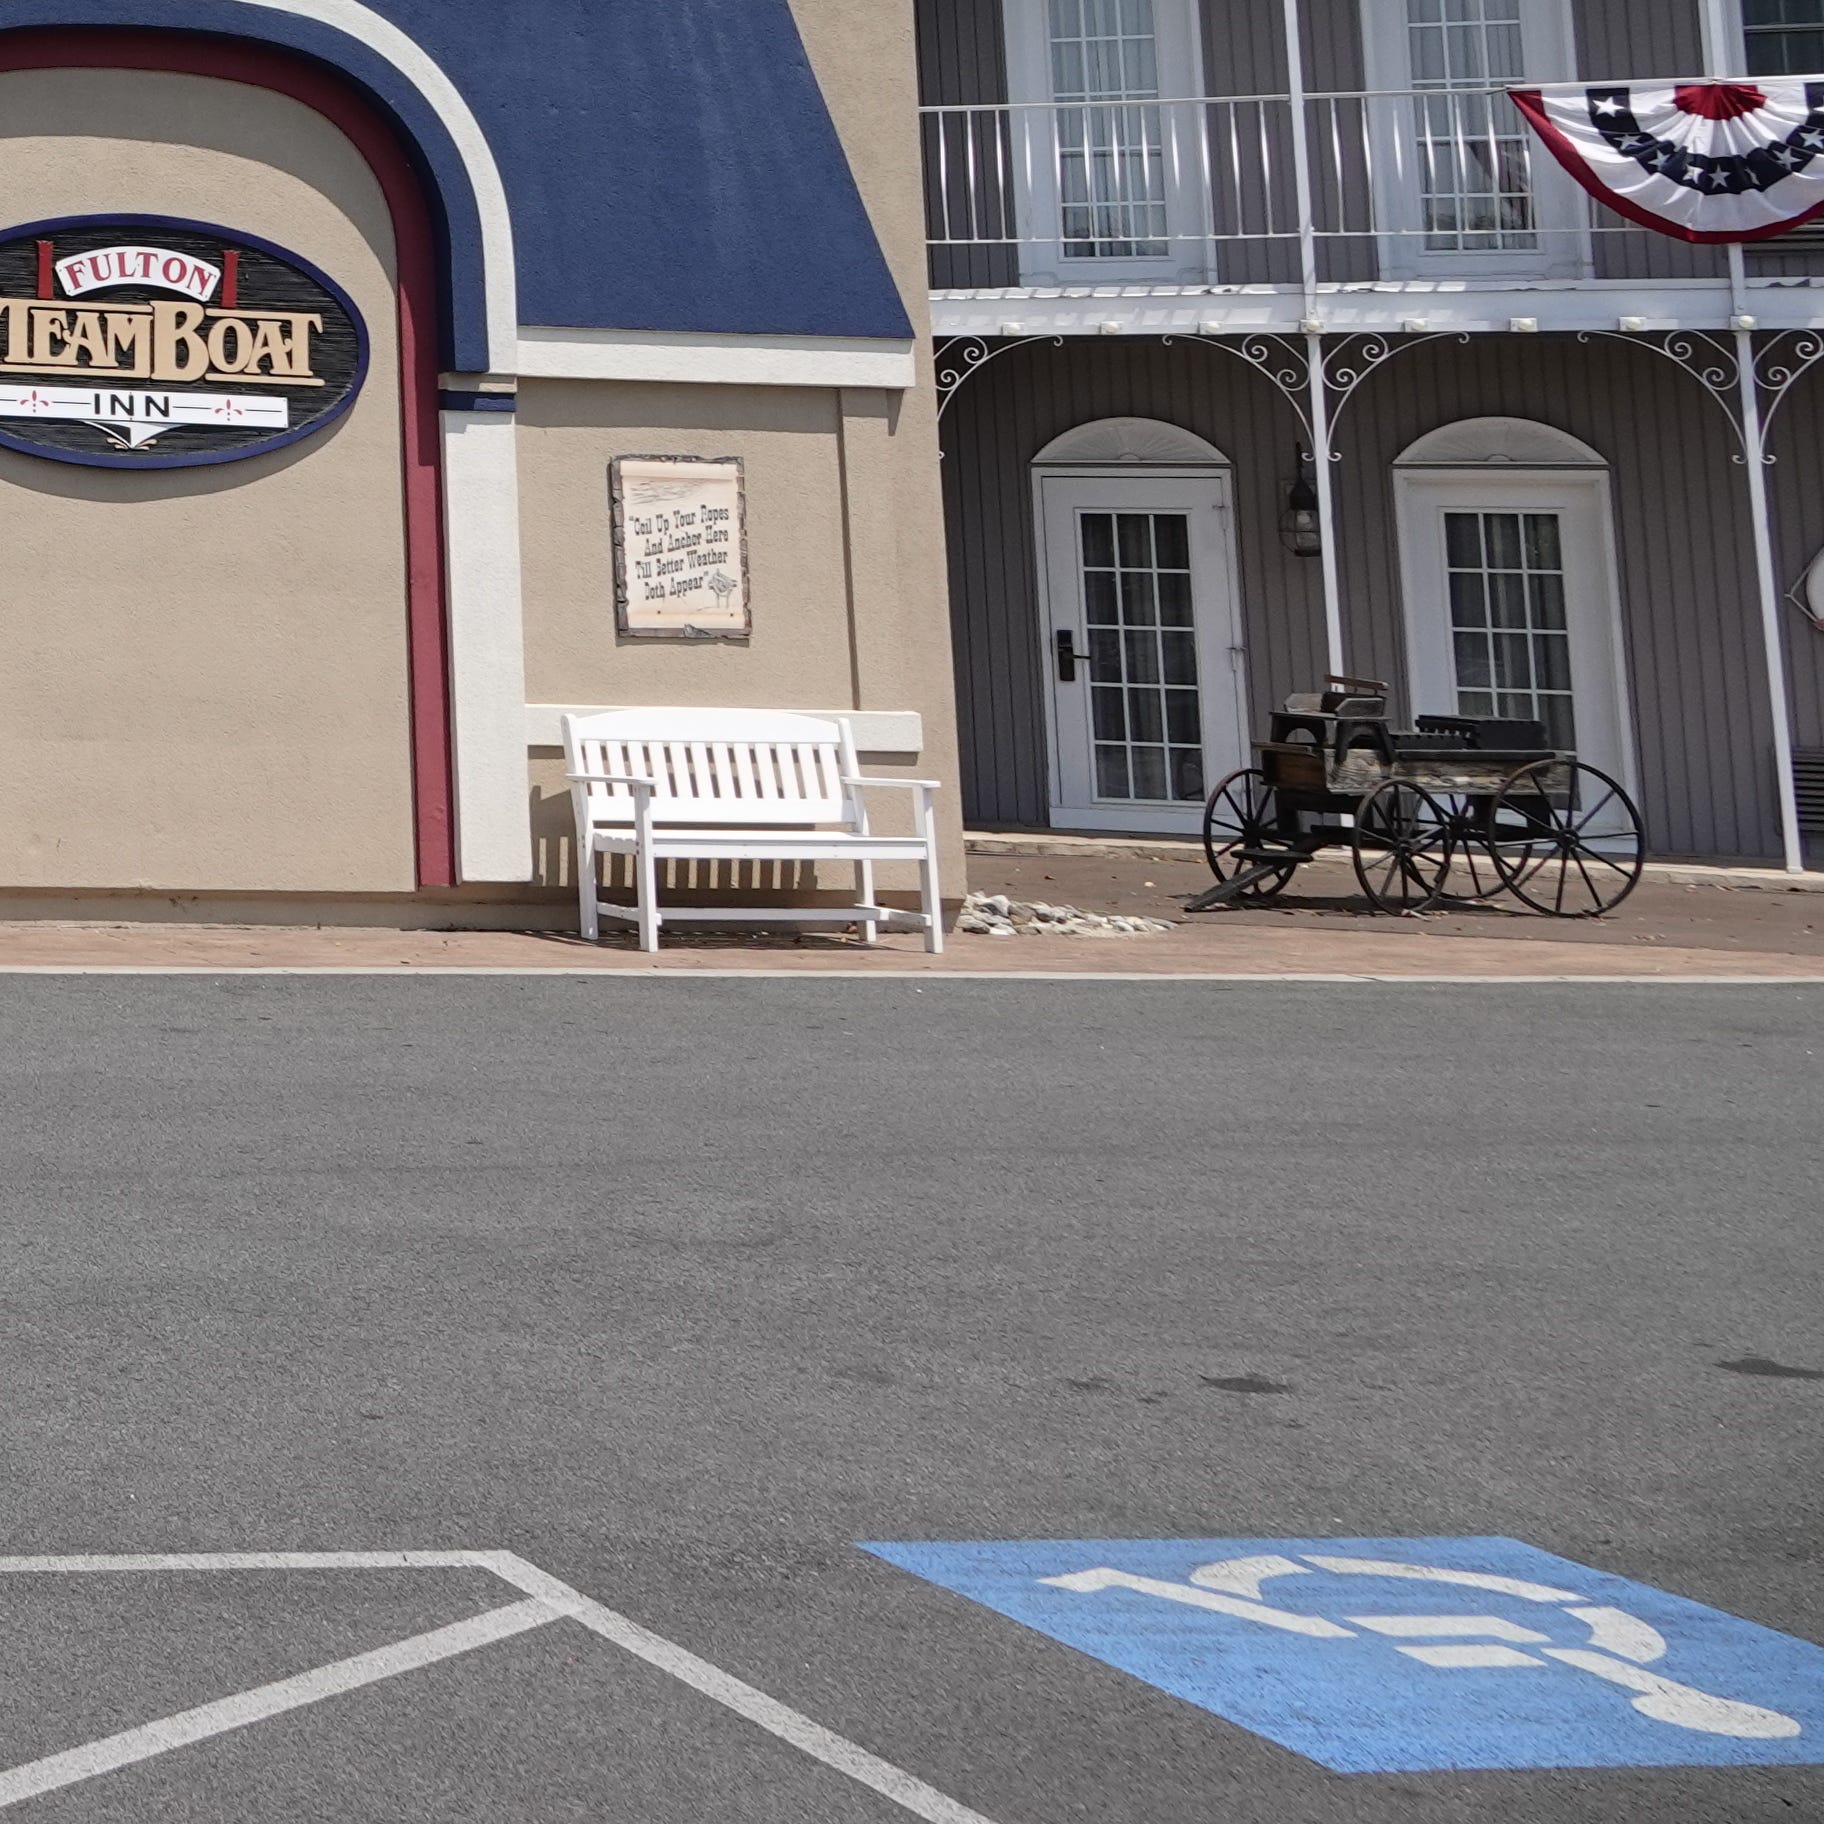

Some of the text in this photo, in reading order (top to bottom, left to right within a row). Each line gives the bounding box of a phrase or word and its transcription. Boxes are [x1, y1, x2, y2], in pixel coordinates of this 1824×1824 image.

[64, 252, 215, 296] FULTON
[93, 392, 171, 418] INN
[656, 513, 669, 535] Up
[673, 509, 697, 529] Your
[700, 504, 729, 525] Ropes
[644, 524, 729, 557] And Anchor Here
[635, 549, 728, 579] Till Better Weather
[644, 582, 666, 600] Doth
